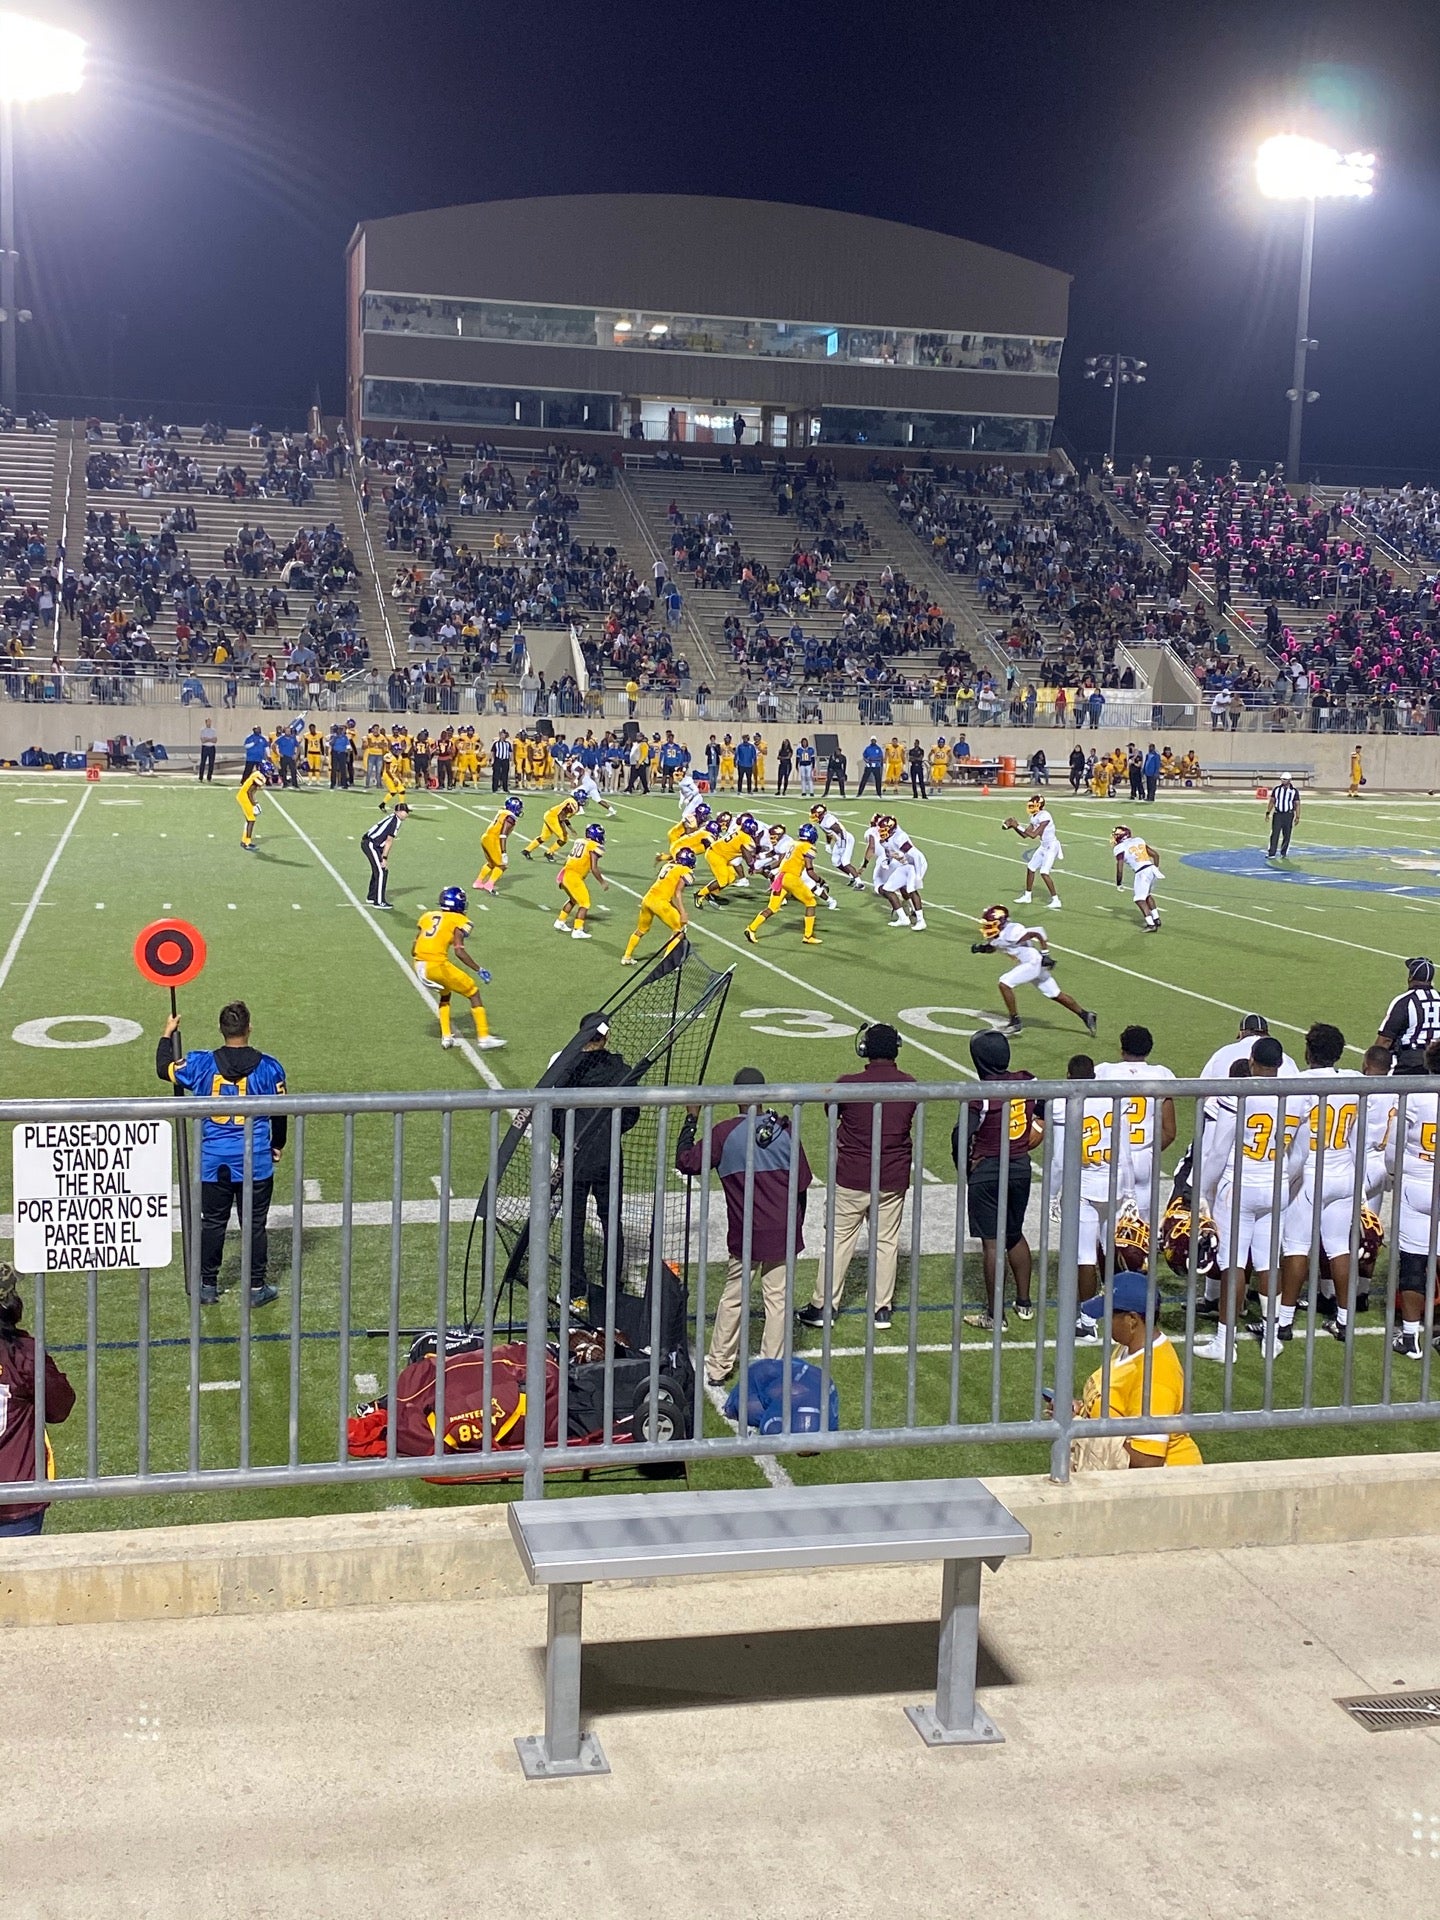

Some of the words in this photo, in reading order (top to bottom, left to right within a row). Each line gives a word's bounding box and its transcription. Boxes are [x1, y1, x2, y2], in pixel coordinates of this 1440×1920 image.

[666, 748, 677, 758] 50
[87, 769, 99, 779] 20
[425, 915, 442, 937] 3
[25, 1125, 91, 1148] PLEASE
[96, 1124, 121, 1147] DO
[125, 1123, 160, 1145] NOT
[53, 1148, 109, 1172] STAND
[112, 1147, 133, 1170] AT
[55, 1173, 88, 1196] THE
[93, 1172, 131, 1195] RAIL
[18, 1200, 53, 1223] POR
[58, 1198, 113, 1221] FAVOR
[118, 1197, 143, 1219] NO
[146, 1196, 168, 1218] SE
[45, 1223, 89, 1246] PARE
[94, 1222, 116, 1245] EN
[121, 1221, 142, 1243] EL
[47, 1246, 140, 1270] BARANDAL
